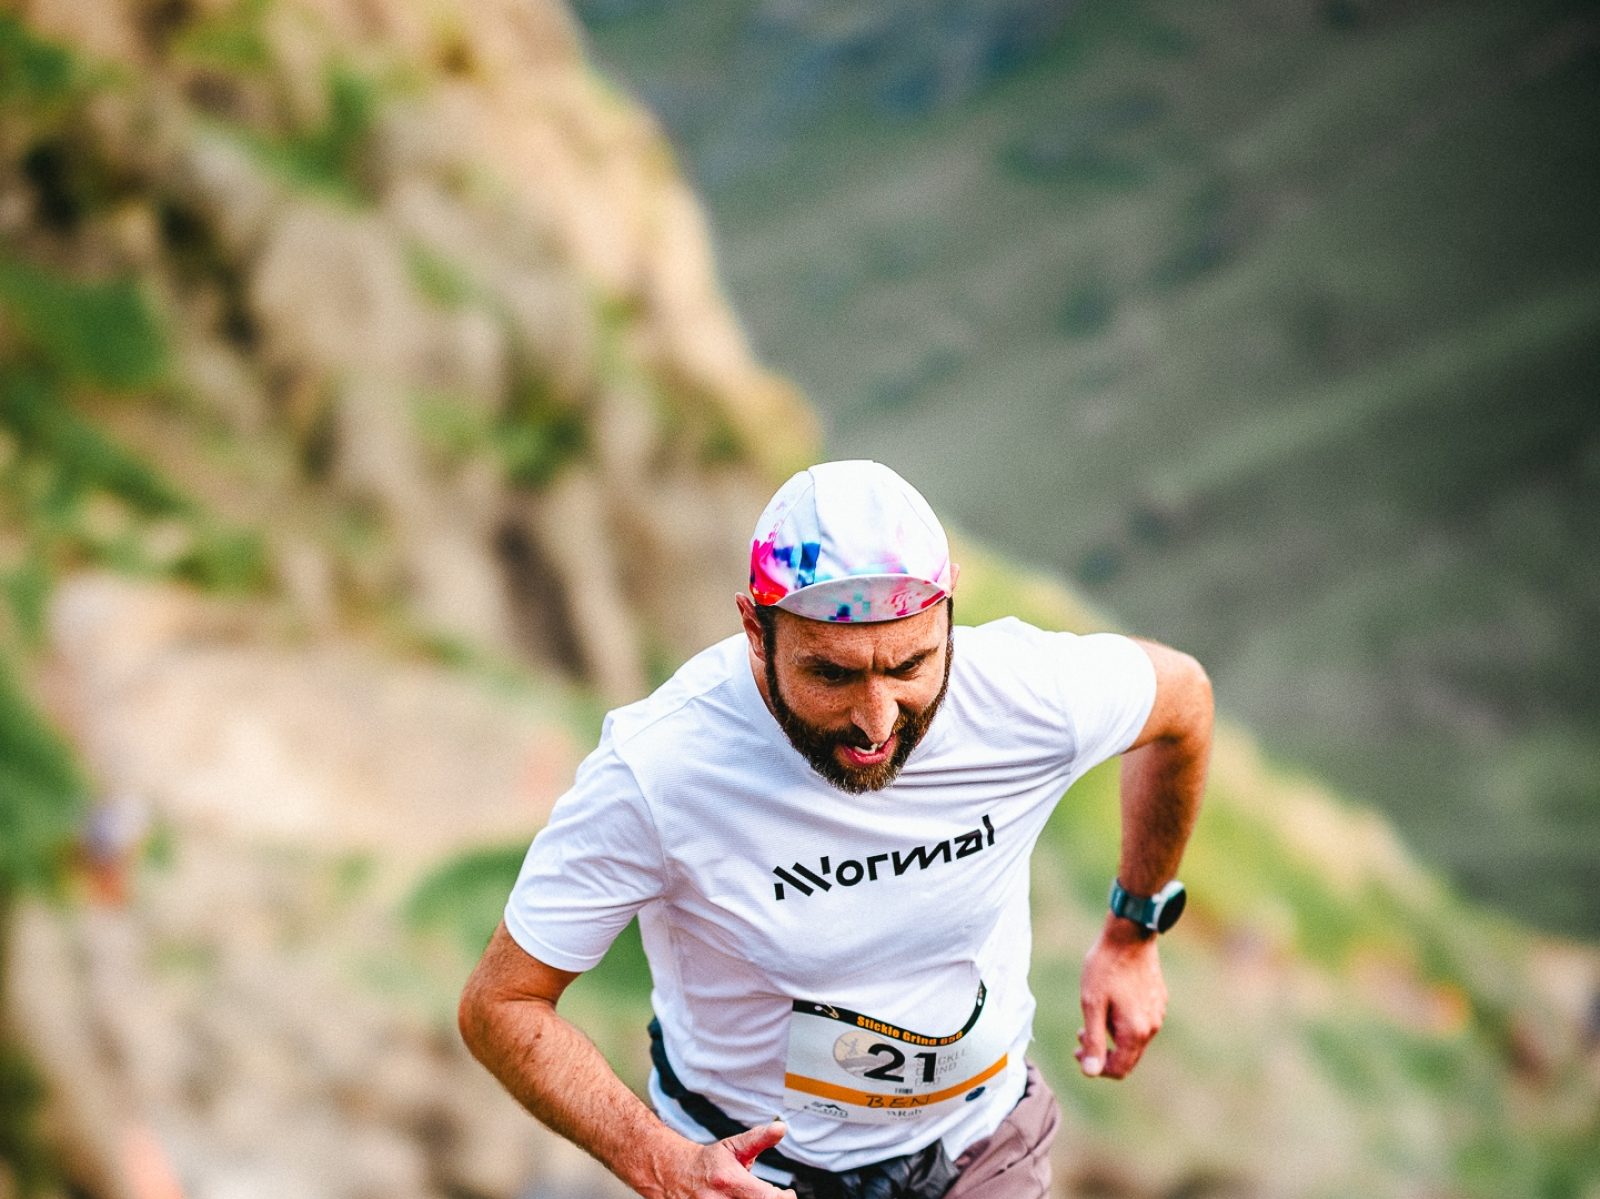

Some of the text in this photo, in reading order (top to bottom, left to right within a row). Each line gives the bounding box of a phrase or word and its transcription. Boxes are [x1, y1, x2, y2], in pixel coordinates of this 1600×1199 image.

[857, 1015, 900, 1038] Stickle
[902, 1031, 937, 1046] Grind
[863, 1043, 937, 1083] 21
[865, 1094, 931, 1109] BEN
